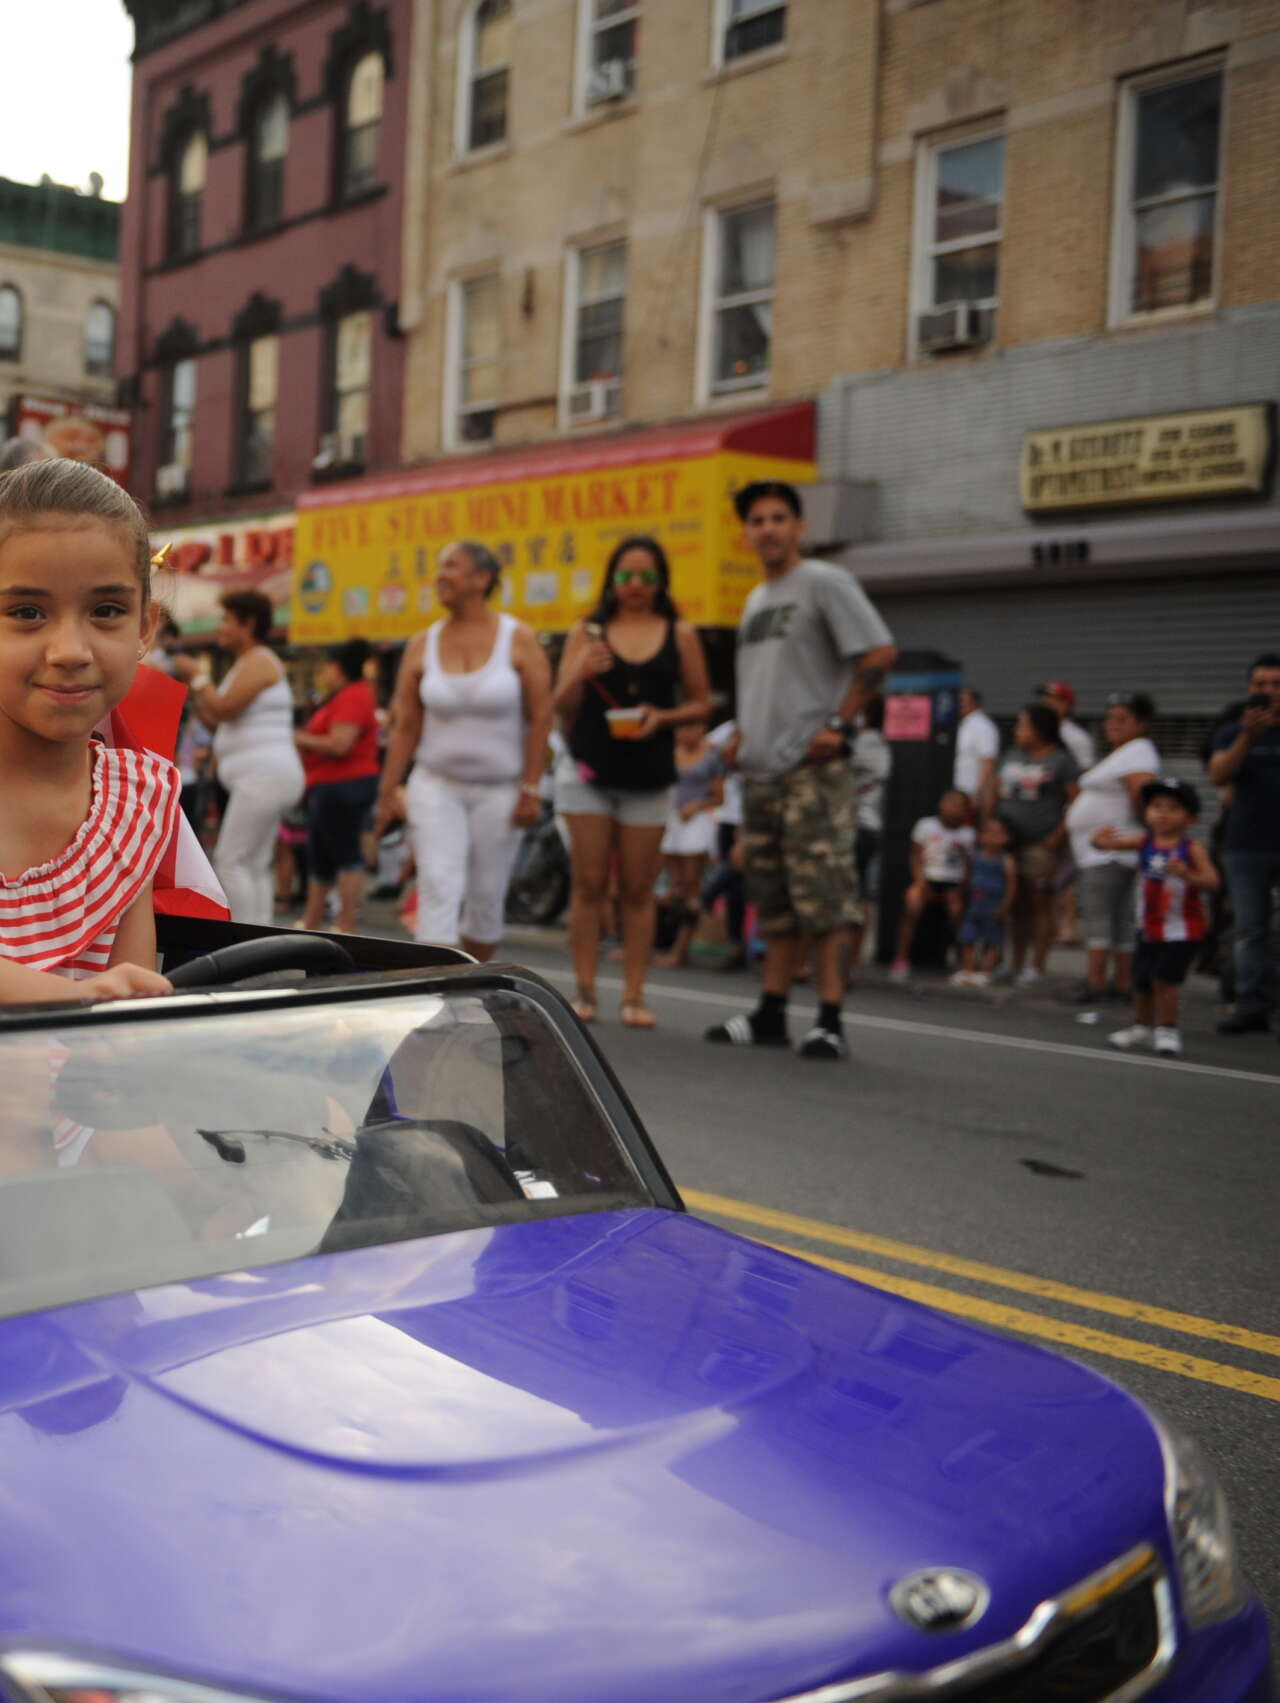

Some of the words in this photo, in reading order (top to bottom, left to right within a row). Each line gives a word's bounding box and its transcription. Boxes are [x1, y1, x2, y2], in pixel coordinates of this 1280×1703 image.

[312, 514, 369, 553] FIVE
[387, 501, 455, 544] STAR
[469, 487, 531, 534] MINI
[543, 470, 679, 525] MARKET
